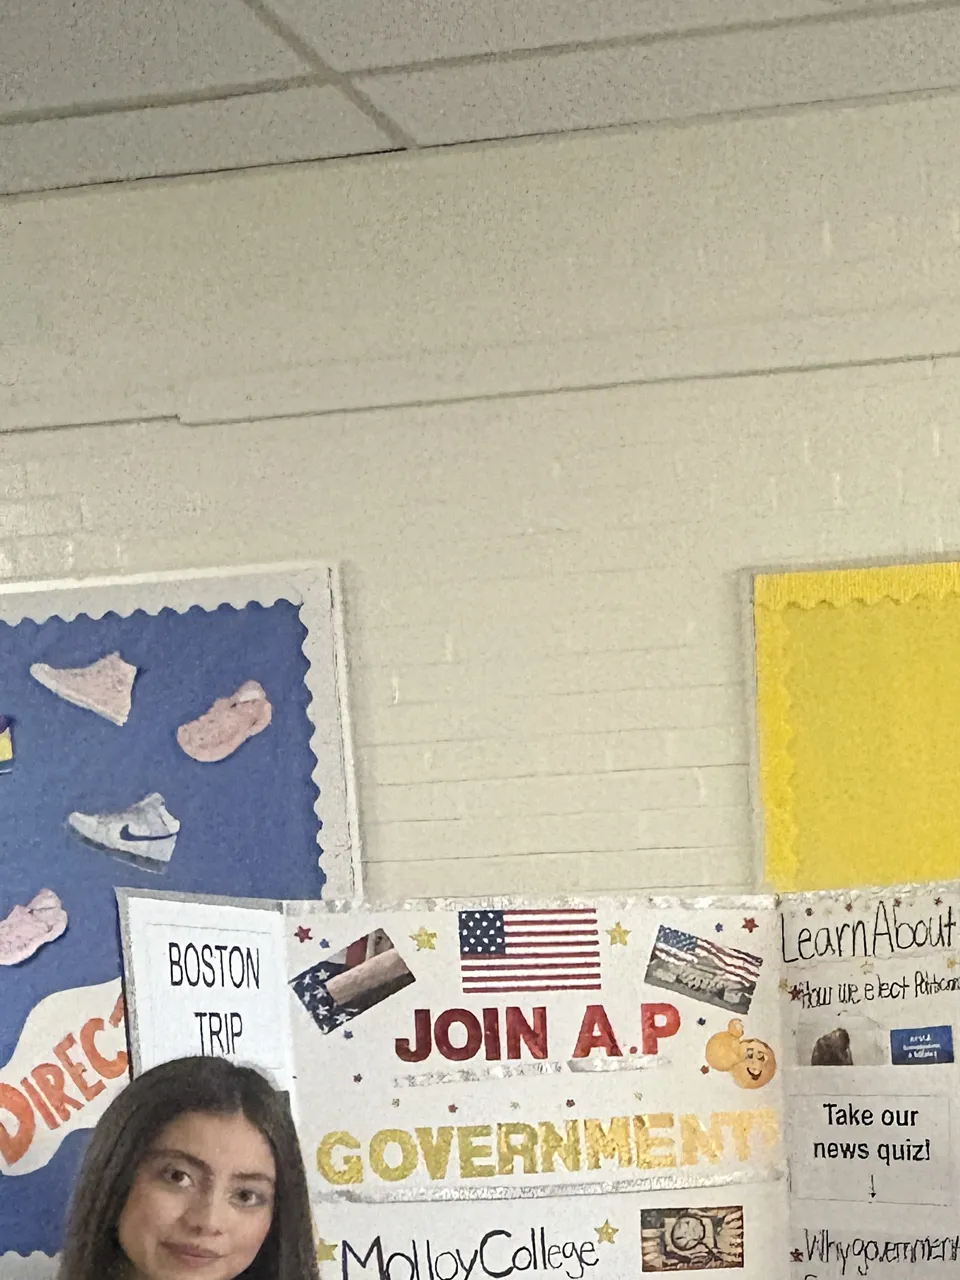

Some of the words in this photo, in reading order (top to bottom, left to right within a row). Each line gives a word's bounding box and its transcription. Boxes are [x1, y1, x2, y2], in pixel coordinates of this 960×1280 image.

[781, 912, 868, 964] Learn
[872, 900, 957, 958] About
[168, 941, 260, 990] BOSTON
[194, 1012, 243, 1056] TRIP
[395, 1006, 549, 1063] JOIN
[0, 995, 128, 1167] DIREC
[822, 1102, 874, 1127] Take
[881, 1109, 920, 1127] our
[813, 1142, 870, 1159] news
[876, 1138, 931, 1167] quiz!
[479, 1227, 600, 1279] College
[804, 1228, 852, 1275] Why
